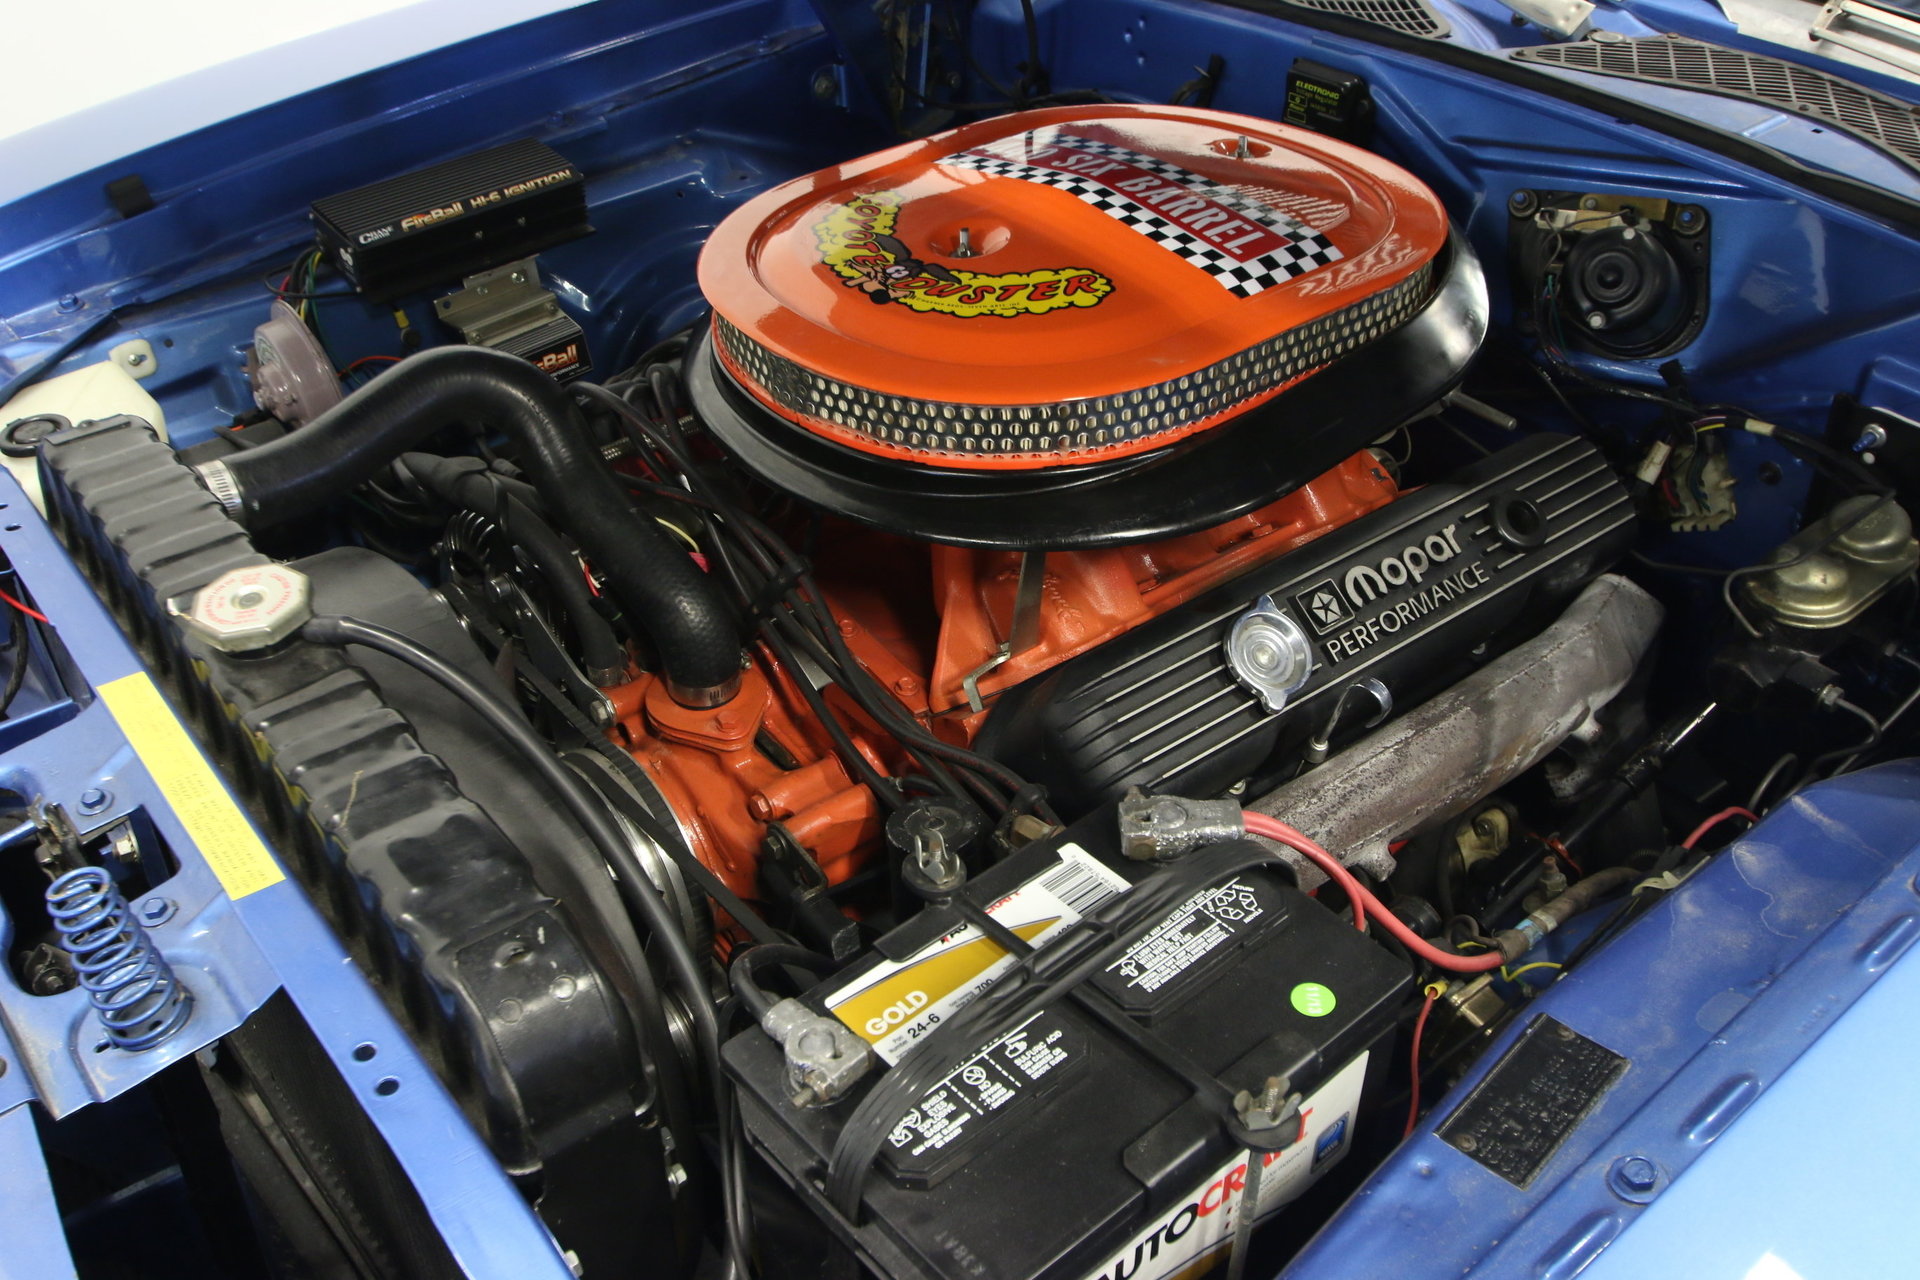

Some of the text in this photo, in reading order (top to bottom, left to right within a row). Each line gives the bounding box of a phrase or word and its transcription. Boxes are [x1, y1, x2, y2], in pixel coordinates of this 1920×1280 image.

[1296, 81, 1340, 100] ELECTRONIC
[401, 201, 464, 232] FireBall
[470, 193, 501, 209] HI-6
[504, 169, 572, 199] IGNITION
[1051, 150, 1266, 255] SIX BARREL
[890, 274, 1100, 305] DUSTER
[1345, 524, 1462, 609] Mopar
[1326, 561, 1490, 663] PERFORMANCE
[1170, 910, 1184, 920] CAPS
[1182, 902, 1196, 912] TIGHT
[1194, 895, 1205, 904] AND
[1203, 886, 1217, 897] LEVEL
[1133, 914, 1196, 959] FLUSH EYES IMMEDIATELY
[1138, 952, 1154, 964] WITH
[1171, 931, 1183, 941] GET
[1144, 932, 1194, 968] MEDICAL HELP FAST
[865, 990, 928, 1035] GOLD
[907, 1013, 940, 1039] 24-6
[1013, 1041, 1047, 1066] SULFURIC
[1046, 1030, 1063, 1045] ACID
[1020, 1048, 1052, 1070] CAN CAUSE
[1025, 1047, 1063, 1076] BLINDNESS OR
[921, 1090, 948, 1111] SHIELD
[978, 1080, 992, 1092] NO
[916, 1102, 957, 1133] EXPLOSIVE
[927, 1100, 948, 1117] EYES
[923, 1118, 950, 1139] GASES
[924, 1134, 943, 1148] CAUSE
[1098, 1107, 1314, 1280] UTOCRT
